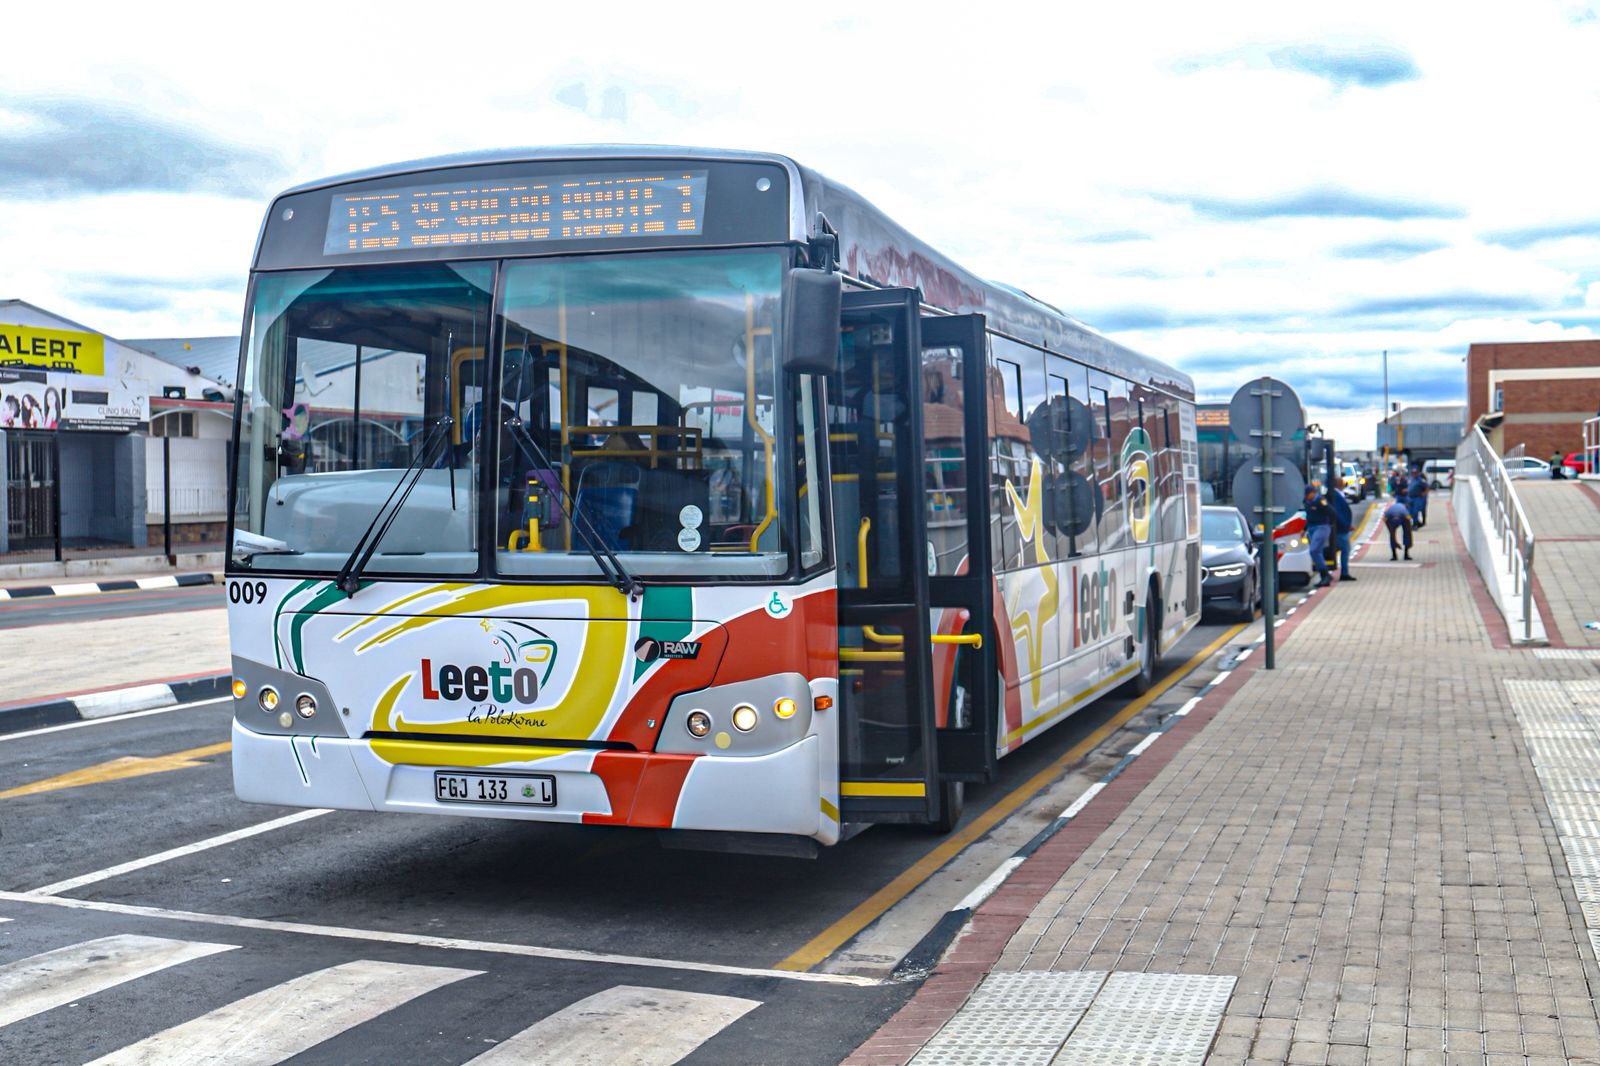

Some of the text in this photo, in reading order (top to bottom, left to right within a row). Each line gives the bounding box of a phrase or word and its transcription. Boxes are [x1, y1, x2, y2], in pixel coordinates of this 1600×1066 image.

[411, 185, 550, 245] SESHEGO
[562, 177, 665, 237] ROUTE
[676, 175, 696, 230] 1
[0, 334, 82, 359] ALERT
[121, 407, 141, 417] SALON
[229, 581, 267, 604] 009
[1073, 559, 1116, 648] Leeto
[664, 642, 697, 654] RAW
[421, 658, 539, 705] Leeto
[438, 777, 552, 802] FGJ 133 L
